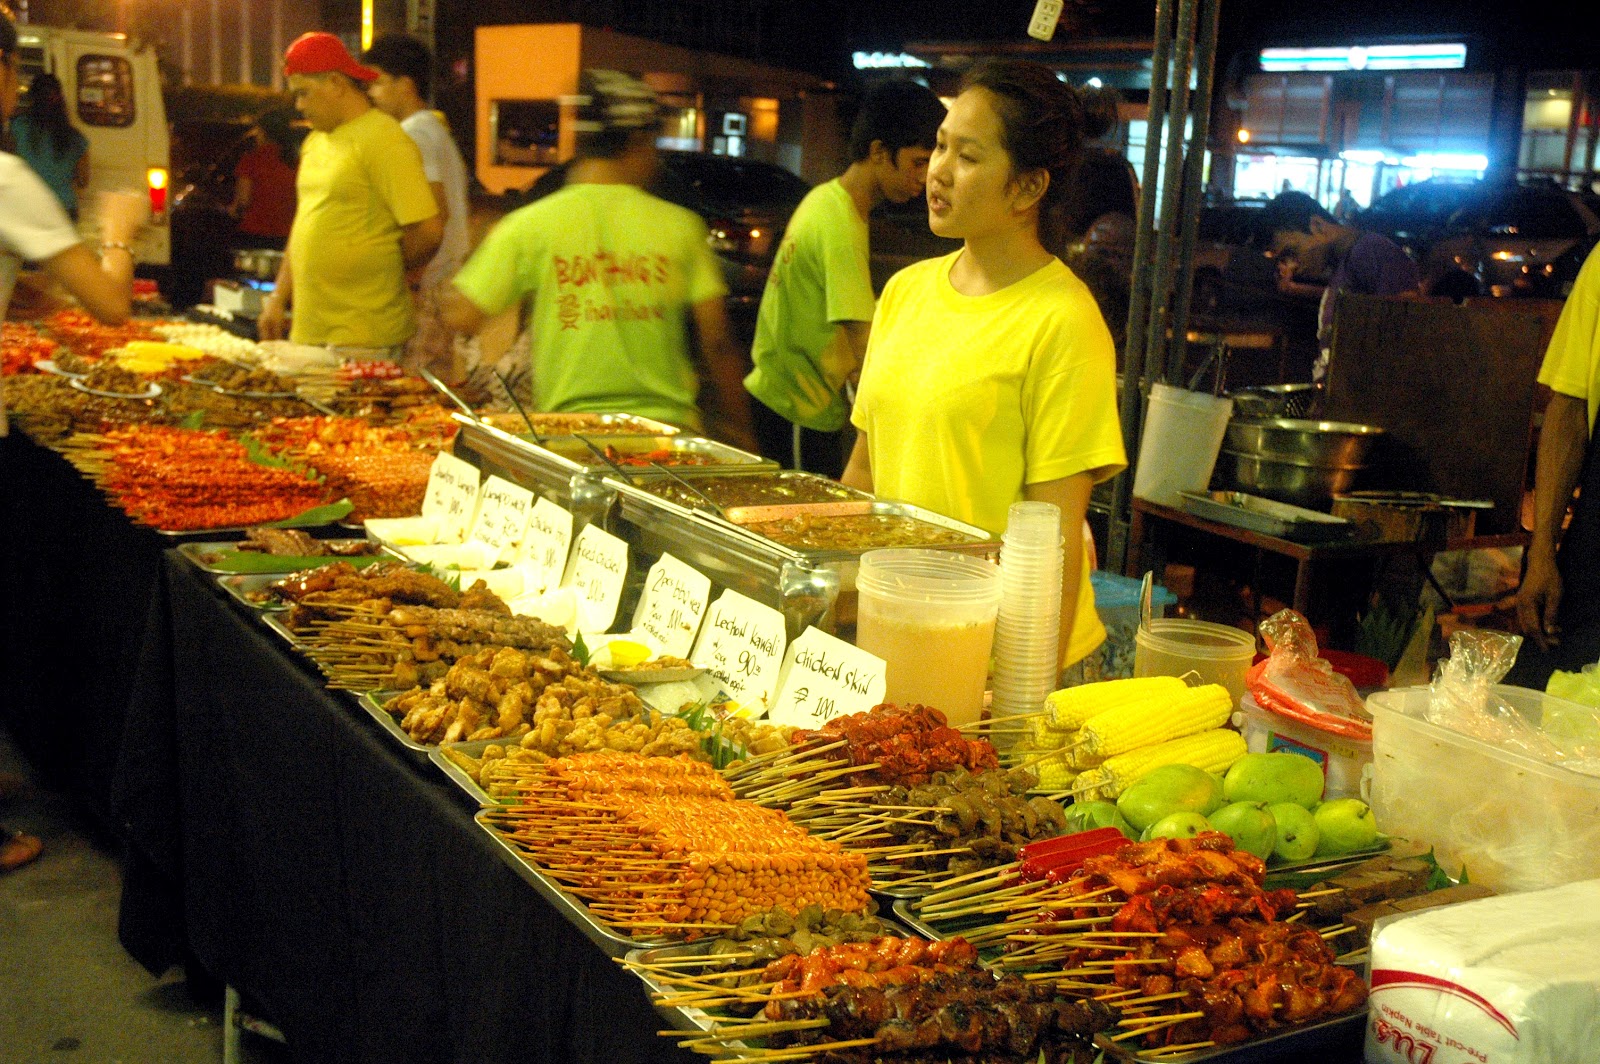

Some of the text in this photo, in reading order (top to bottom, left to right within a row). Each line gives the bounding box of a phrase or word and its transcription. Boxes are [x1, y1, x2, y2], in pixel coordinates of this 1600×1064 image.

[1380, 1002, 1489, 1064] Pre-cut Table Napkin
